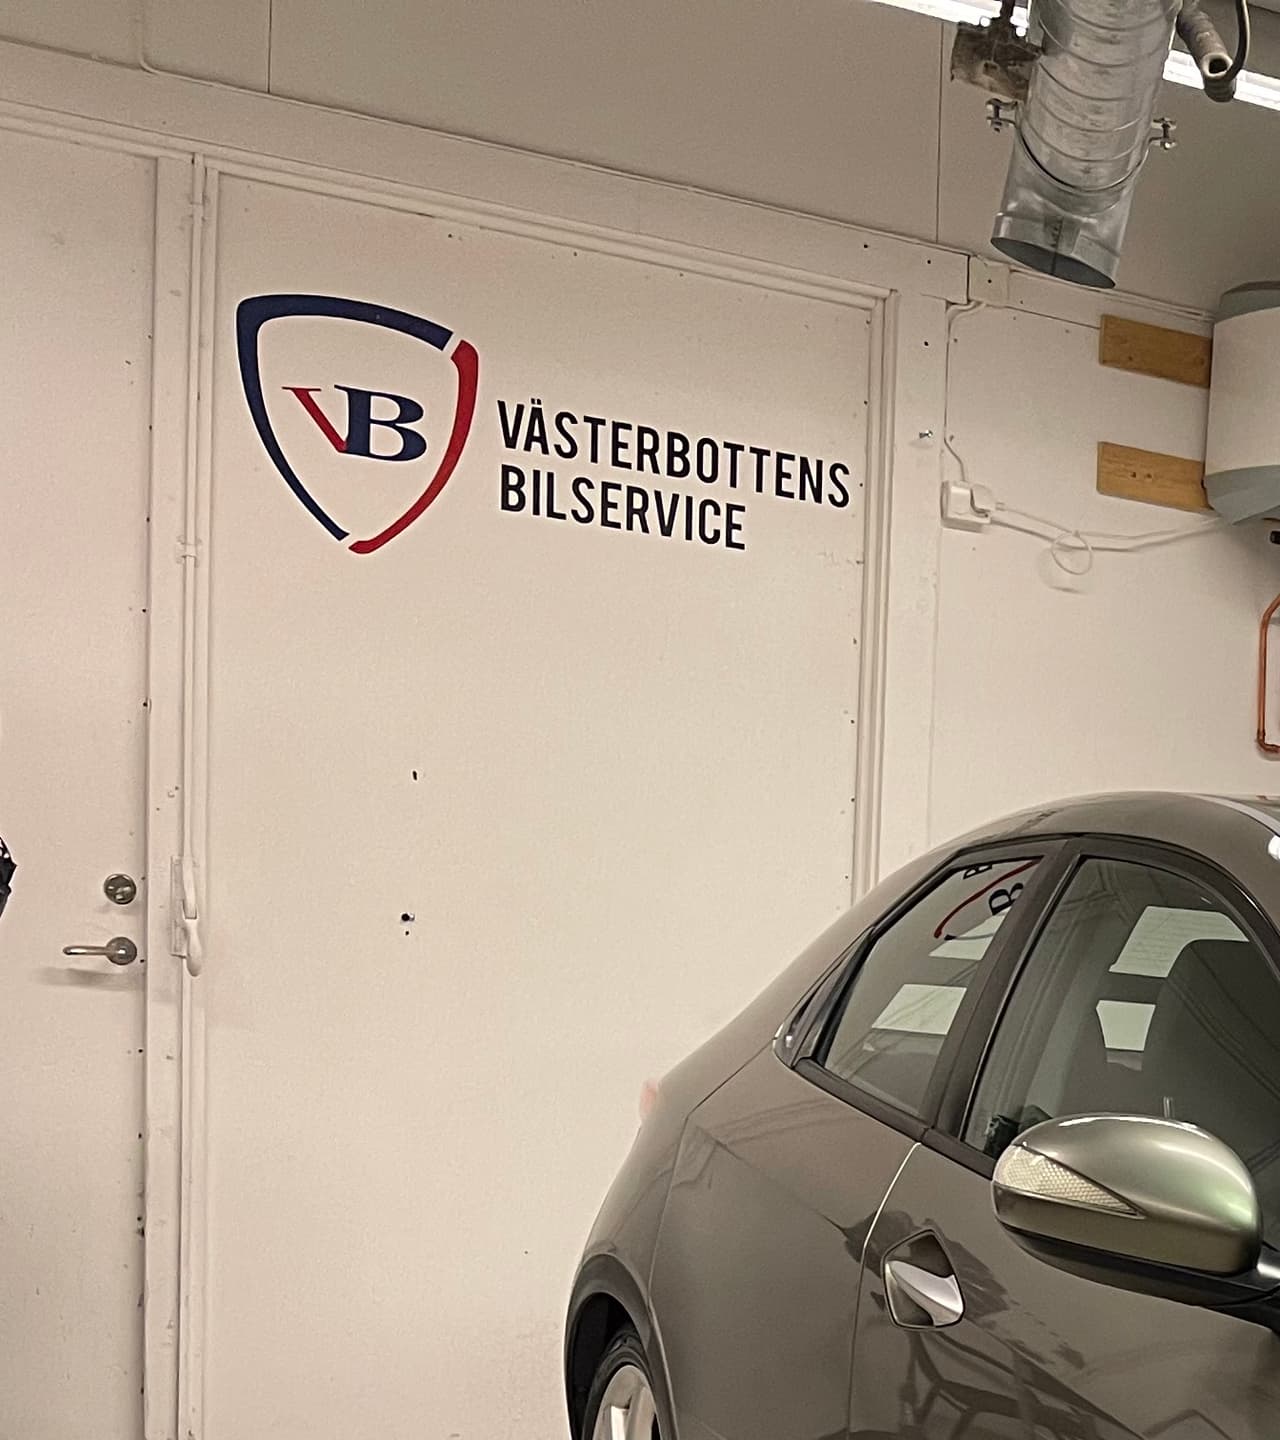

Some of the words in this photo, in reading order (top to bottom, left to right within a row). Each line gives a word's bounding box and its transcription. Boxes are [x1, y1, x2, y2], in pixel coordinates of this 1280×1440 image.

[282, 385, 427, 462] VB
[498, 398, 850, 508] VÄSTERBOTTENS
[500, 463, 746, 551] BILSERVICE
